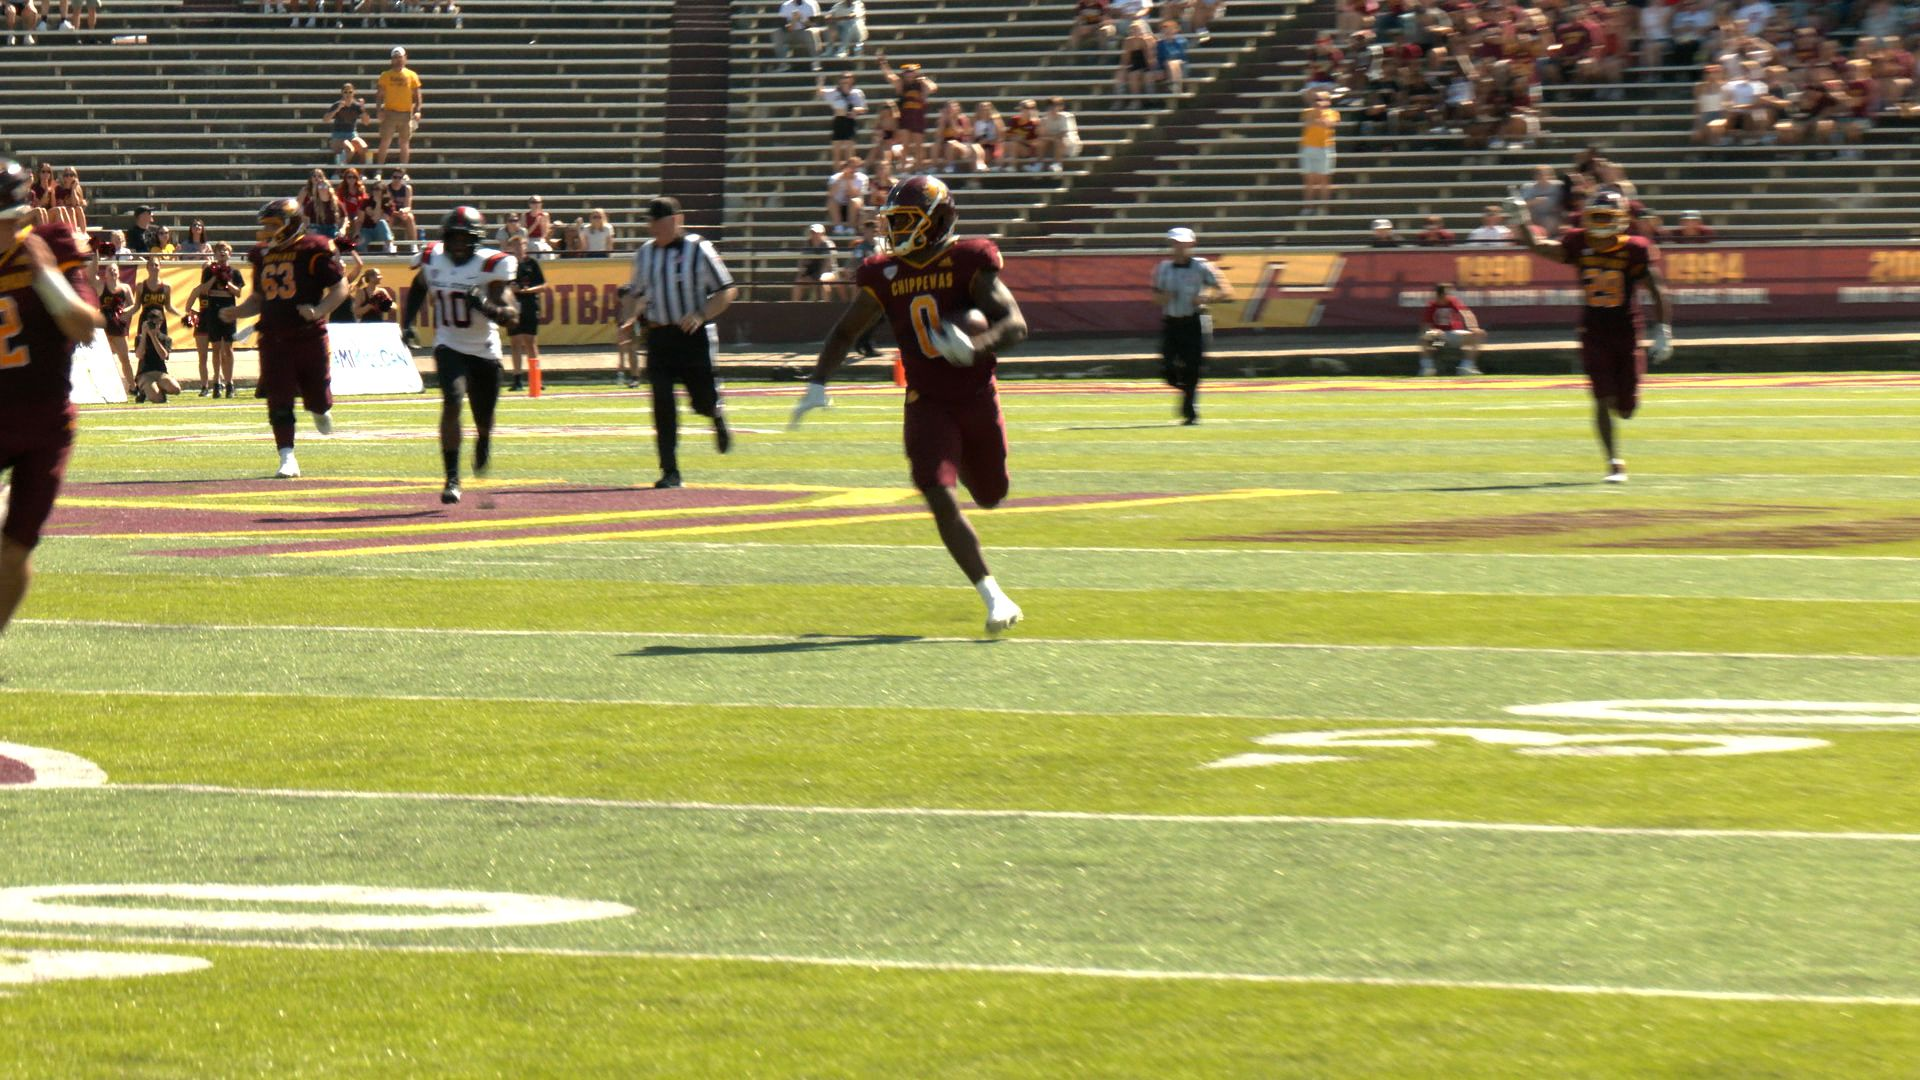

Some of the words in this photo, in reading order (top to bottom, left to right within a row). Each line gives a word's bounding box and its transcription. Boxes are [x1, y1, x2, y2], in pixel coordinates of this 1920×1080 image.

[261, 262, 297, 300] 63
[891, 271, 953, 297] CHIPPEWAS
[1455, 254, 1531, 286] 1990
[435, 289, 471, 328] 10
[910, 294, 942, 358] 0
